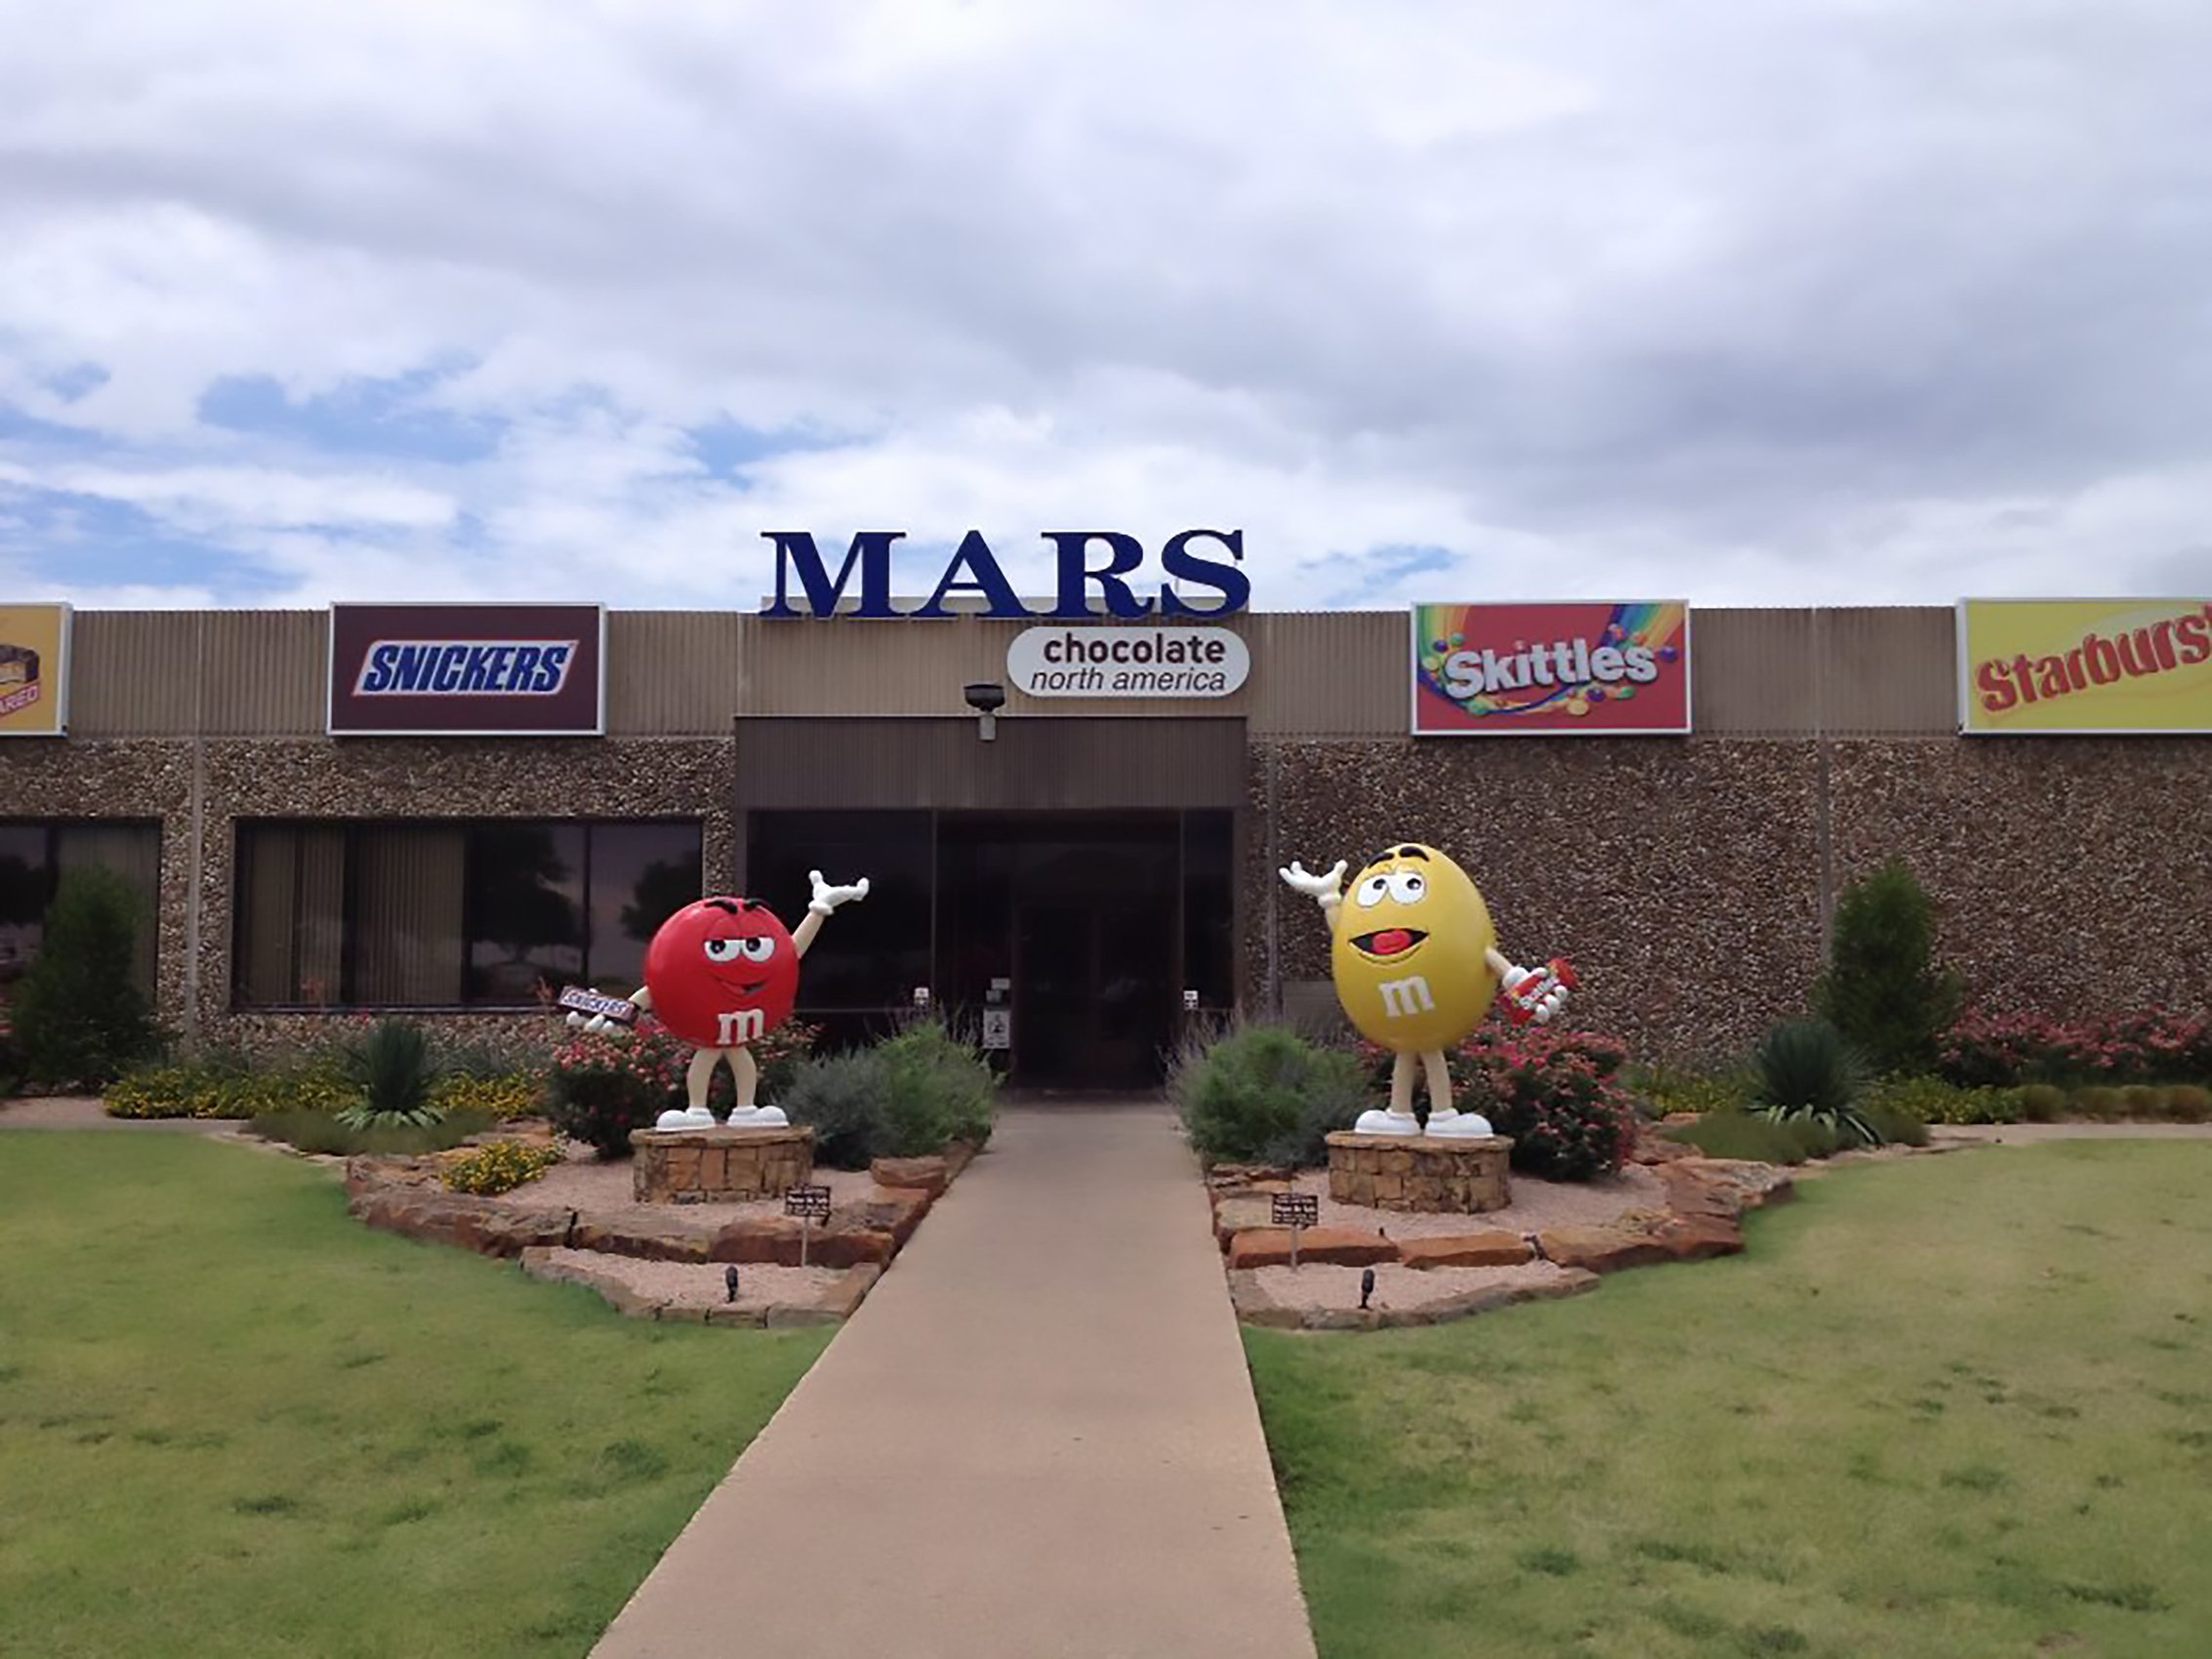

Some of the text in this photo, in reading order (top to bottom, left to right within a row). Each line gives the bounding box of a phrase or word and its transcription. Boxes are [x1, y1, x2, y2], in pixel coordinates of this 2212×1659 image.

[758, 529, 1251, 620] MARS
[362, 644, 570, 693] SNICKERS
[1044, 632, 1226, 664] chocolate
[1443, 637, 1658, 700] Skittles
[1976, 602, 2212, 712] Starburs
[1030, 667, 1226, 692] north america
[1378, 975, 1435, 1017] m
[716, 1008, 764, 1044] m
